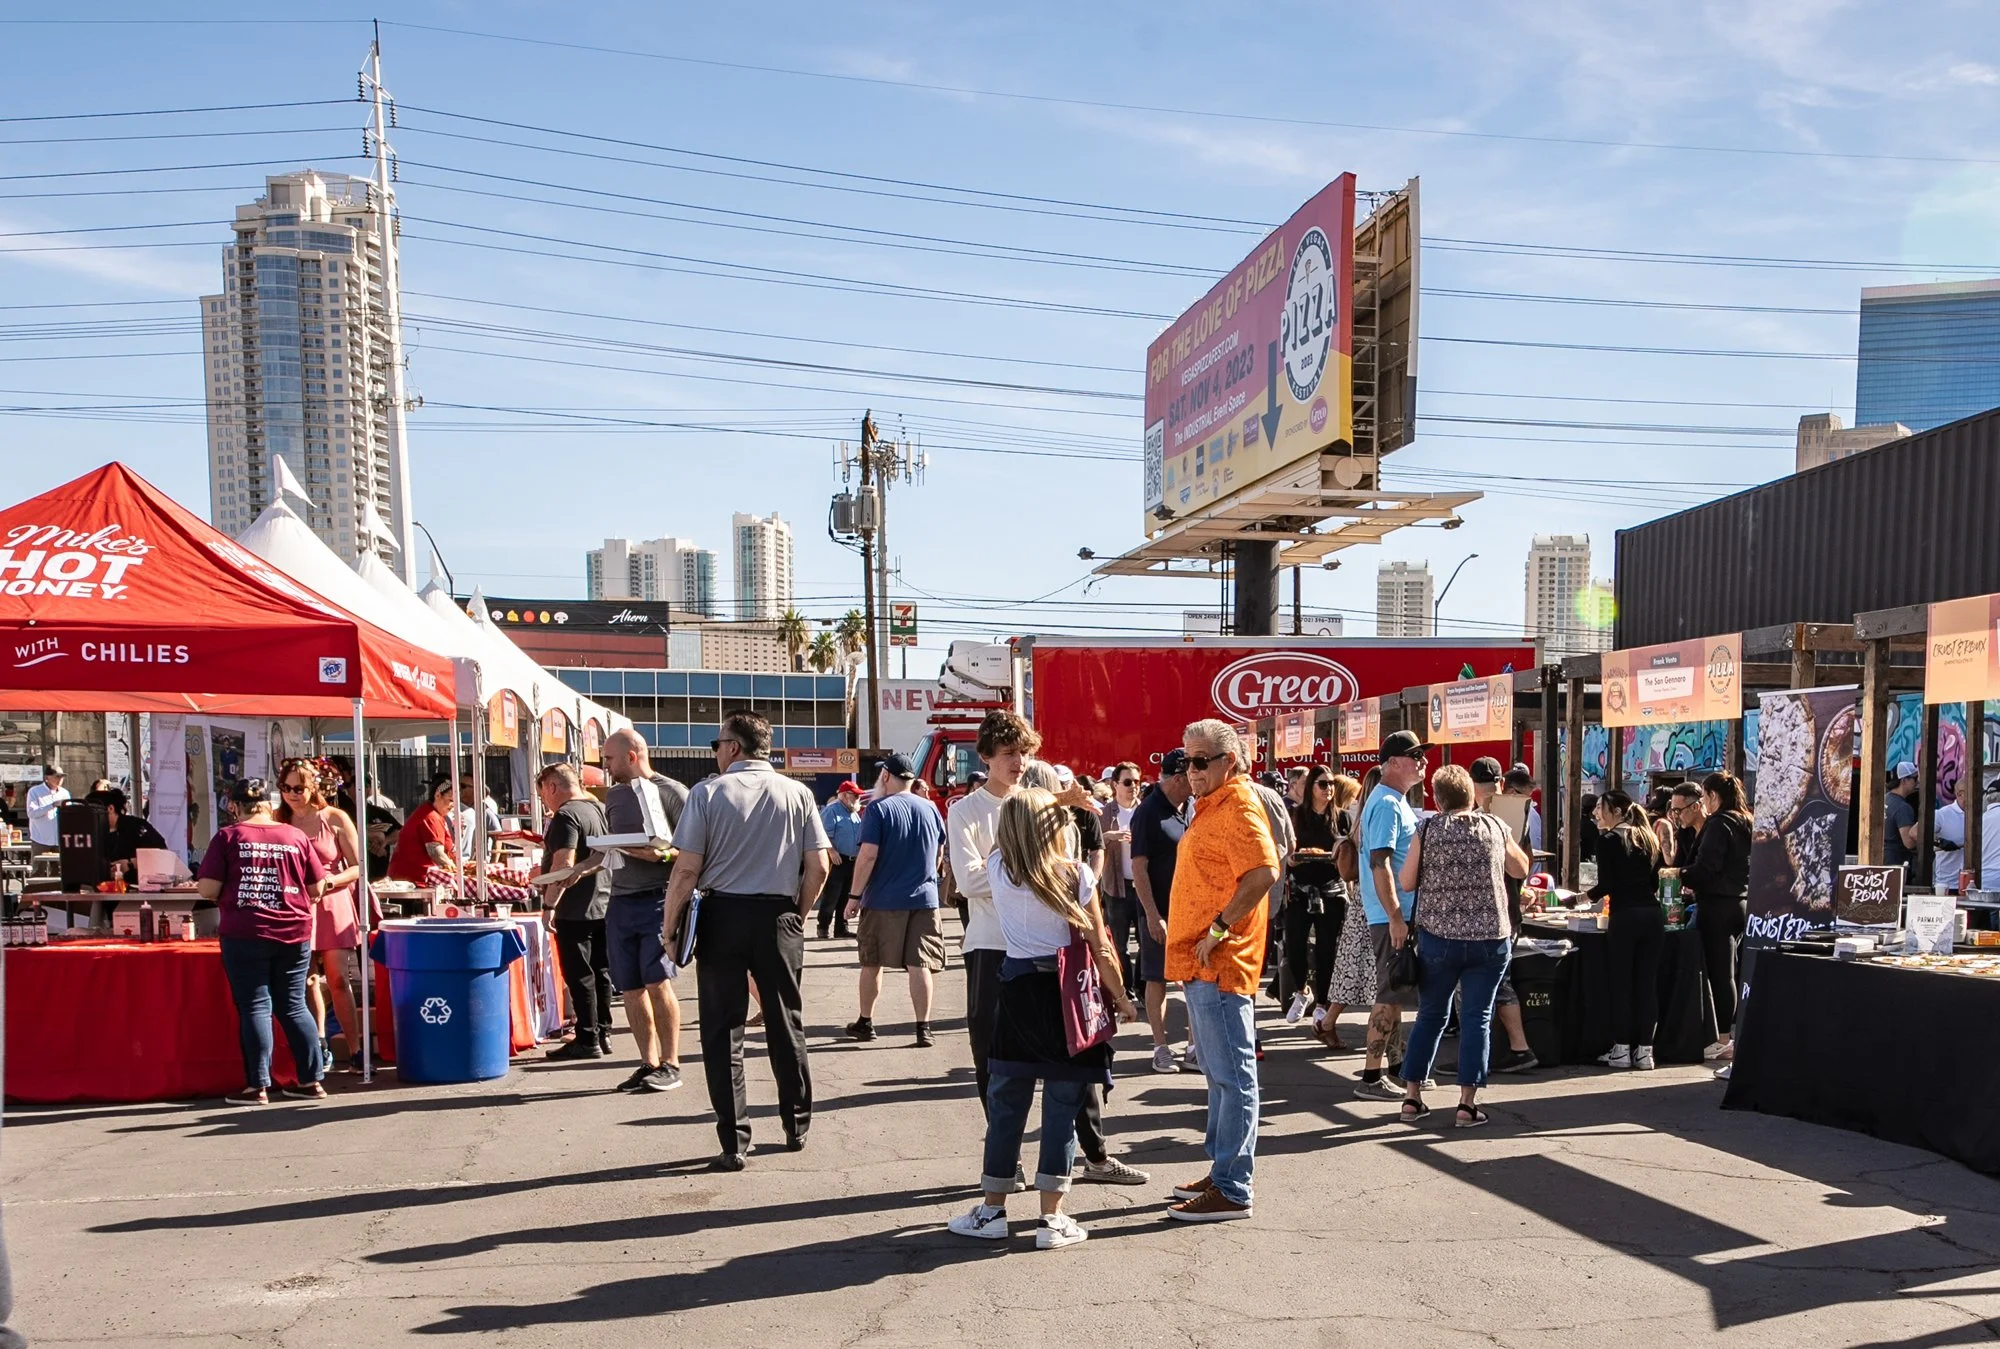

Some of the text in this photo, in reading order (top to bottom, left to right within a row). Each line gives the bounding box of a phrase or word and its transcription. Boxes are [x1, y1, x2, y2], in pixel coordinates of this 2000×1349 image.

[1305, 233, 1325, 251] VEGAS
[1150, 236, 1286, 390] FOR THE LOVE OF PIZZA
[1280, 274, 1337, 358] PIZZA
[1181, 329, 1239, 387] VEGASPIZZAFEST.COM
[1301, 353, 1313, 371] 2023
[1190, 375, 1209, 413] NOV
[1225, 343, 1254, 391] 2023
[1291, 367, 1322, 399] FESTIVAL
[1174, 390, 1246, 448] The INDUSTRIAL Event Space
[1311, 405, 1328, 424] Greco
[3, 524, 156, 555] Mike's
[0, 549, 143, 584] HOT
[608, 609, 648, 624] Ahern
[895, 605, 912, 627] 7
[14, 637, 189, 664] WITH CHILIES
[1932, 638, 1958, 658] CRUST
[1707, 661, 1735, 678] PIZZA
[1227, 669, 1342, 709] Greco
[1644, 675, 1687, 686] The San Gennaro
[1256, 708, 1282, 716] AND
[1322, 752, 1380, 763] Tmatoes
[62, 833, 92, 848] TCI
[238, 842, 300, 855] TO THE PERSON
[239, 850, 284, 860] BEHIND ME:
[240, 866, 278, 875] YOU ARE
[1844, 869, 1895, 890] CRUST
[238, 883, 299, 894] BEAUTIFUL AND
[240, 875, 280, 885] AMAZING,
[237, 891, 278, 900] ENOUGH.
[1850, 887, 1890, 905] ROUX
[1745, 913, 1790, 942] CRUST
